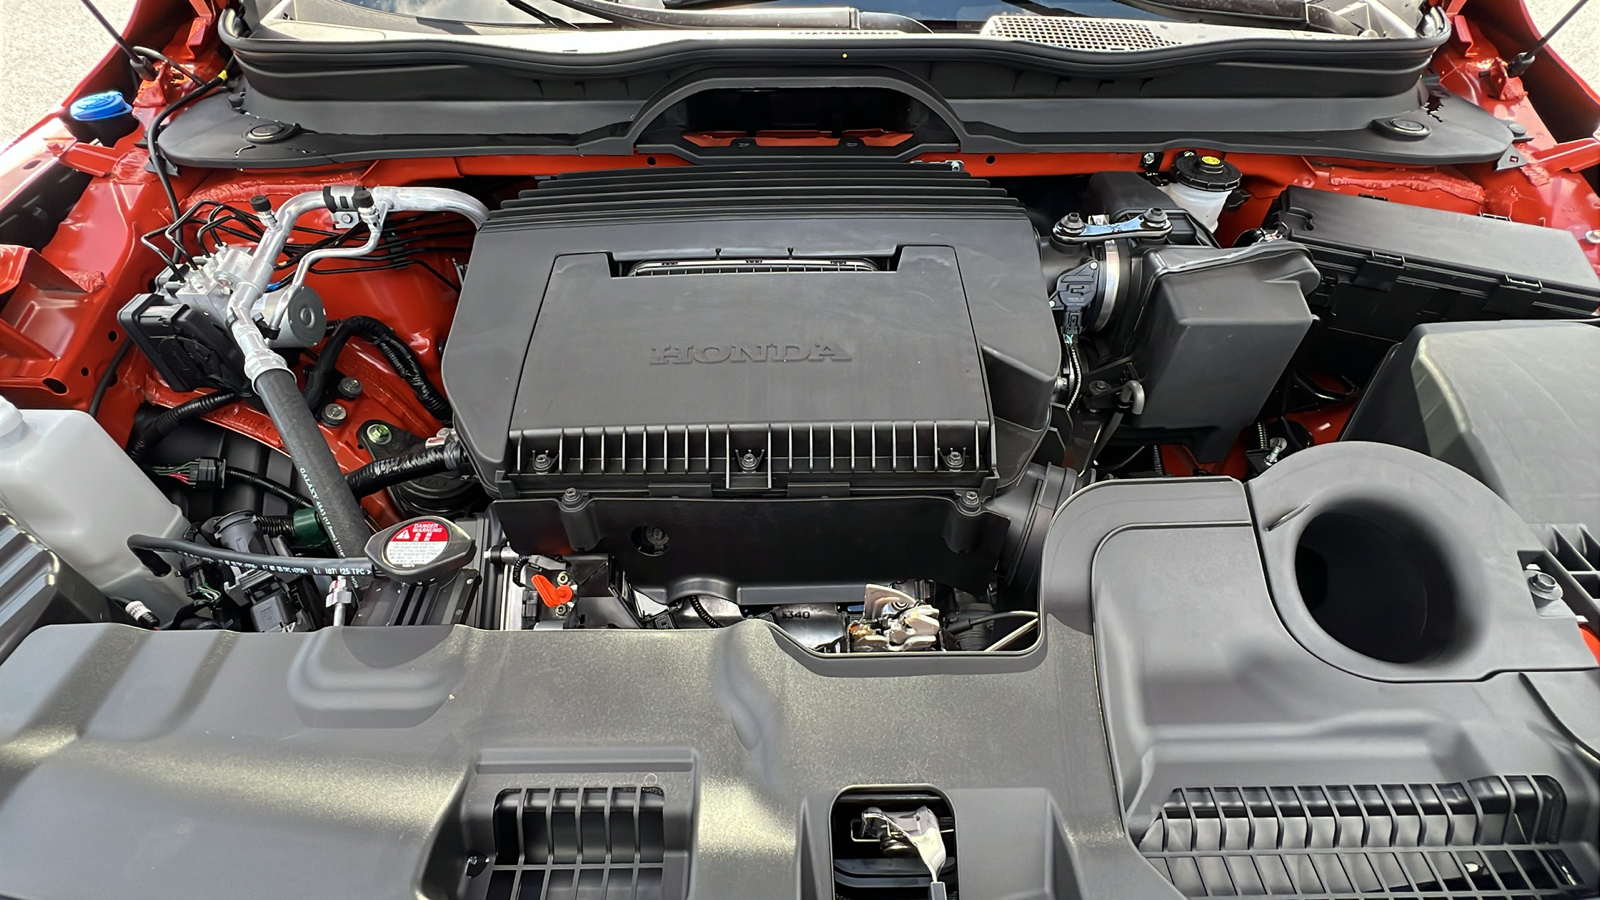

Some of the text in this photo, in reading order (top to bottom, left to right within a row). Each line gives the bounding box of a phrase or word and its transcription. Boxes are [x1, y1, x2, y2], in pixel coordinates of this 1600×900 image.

[649, 343, 853, 365] HONDA
[299, 467, 319, 499] GALAXY
[351, 567, 365, 575] TPC
